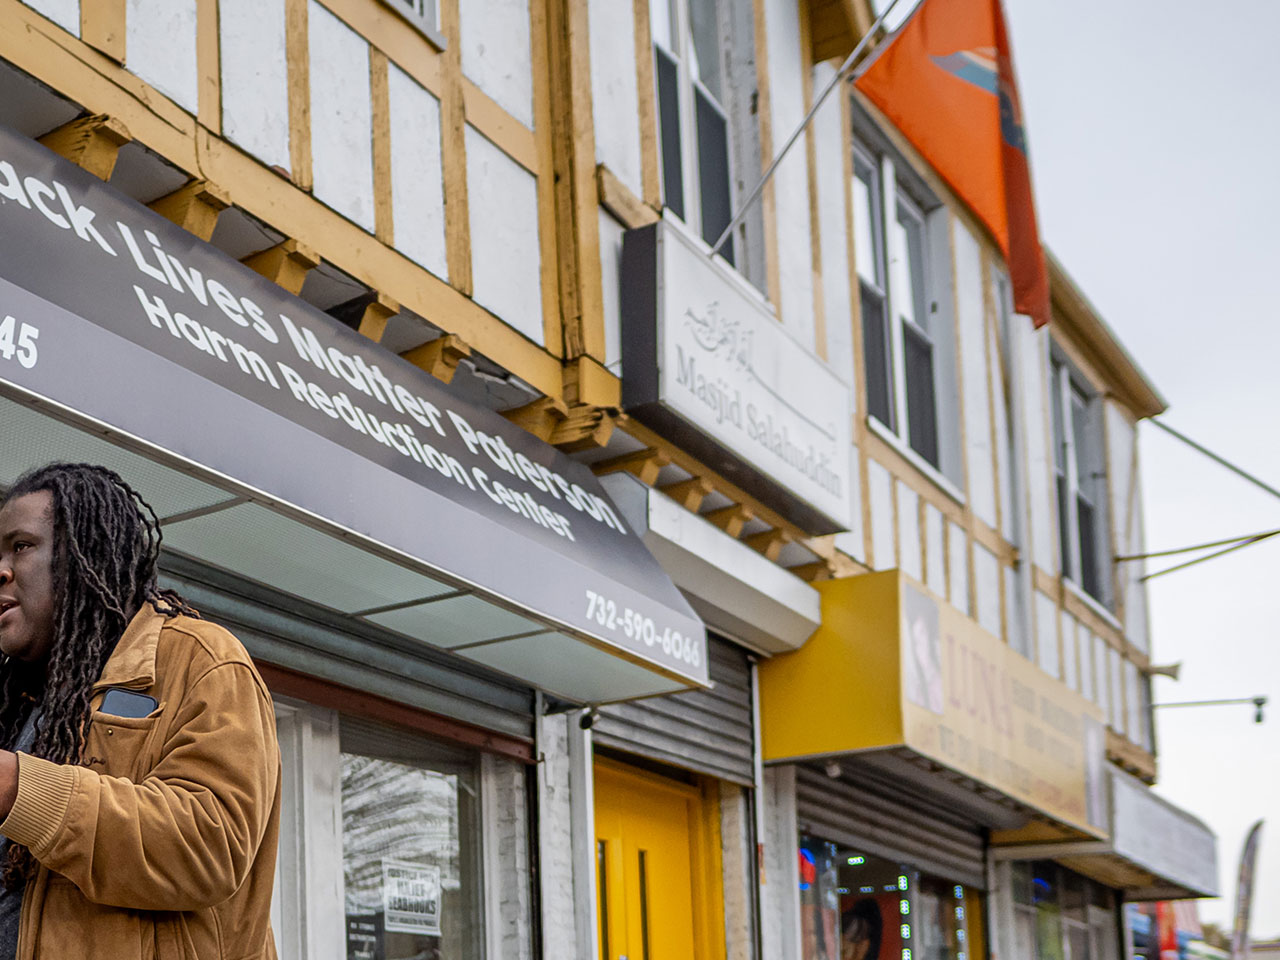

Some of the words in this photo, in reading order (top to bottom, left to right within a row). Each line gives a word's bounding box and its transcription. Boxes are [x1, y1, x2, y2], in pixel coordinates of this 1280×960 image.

[117, 221, 279, 344] Lives
[280, 313, 447, 437] Matter
[446, 409, 627, 535] Paterson
[133, 285, 280, 389] Harm
[277, 362, 476, 491] Reduction
[471, 466, 576, 541] Center
[676, 344, 742, 429] Masjid
[585, 591, 700, 667] 732-590-6066
